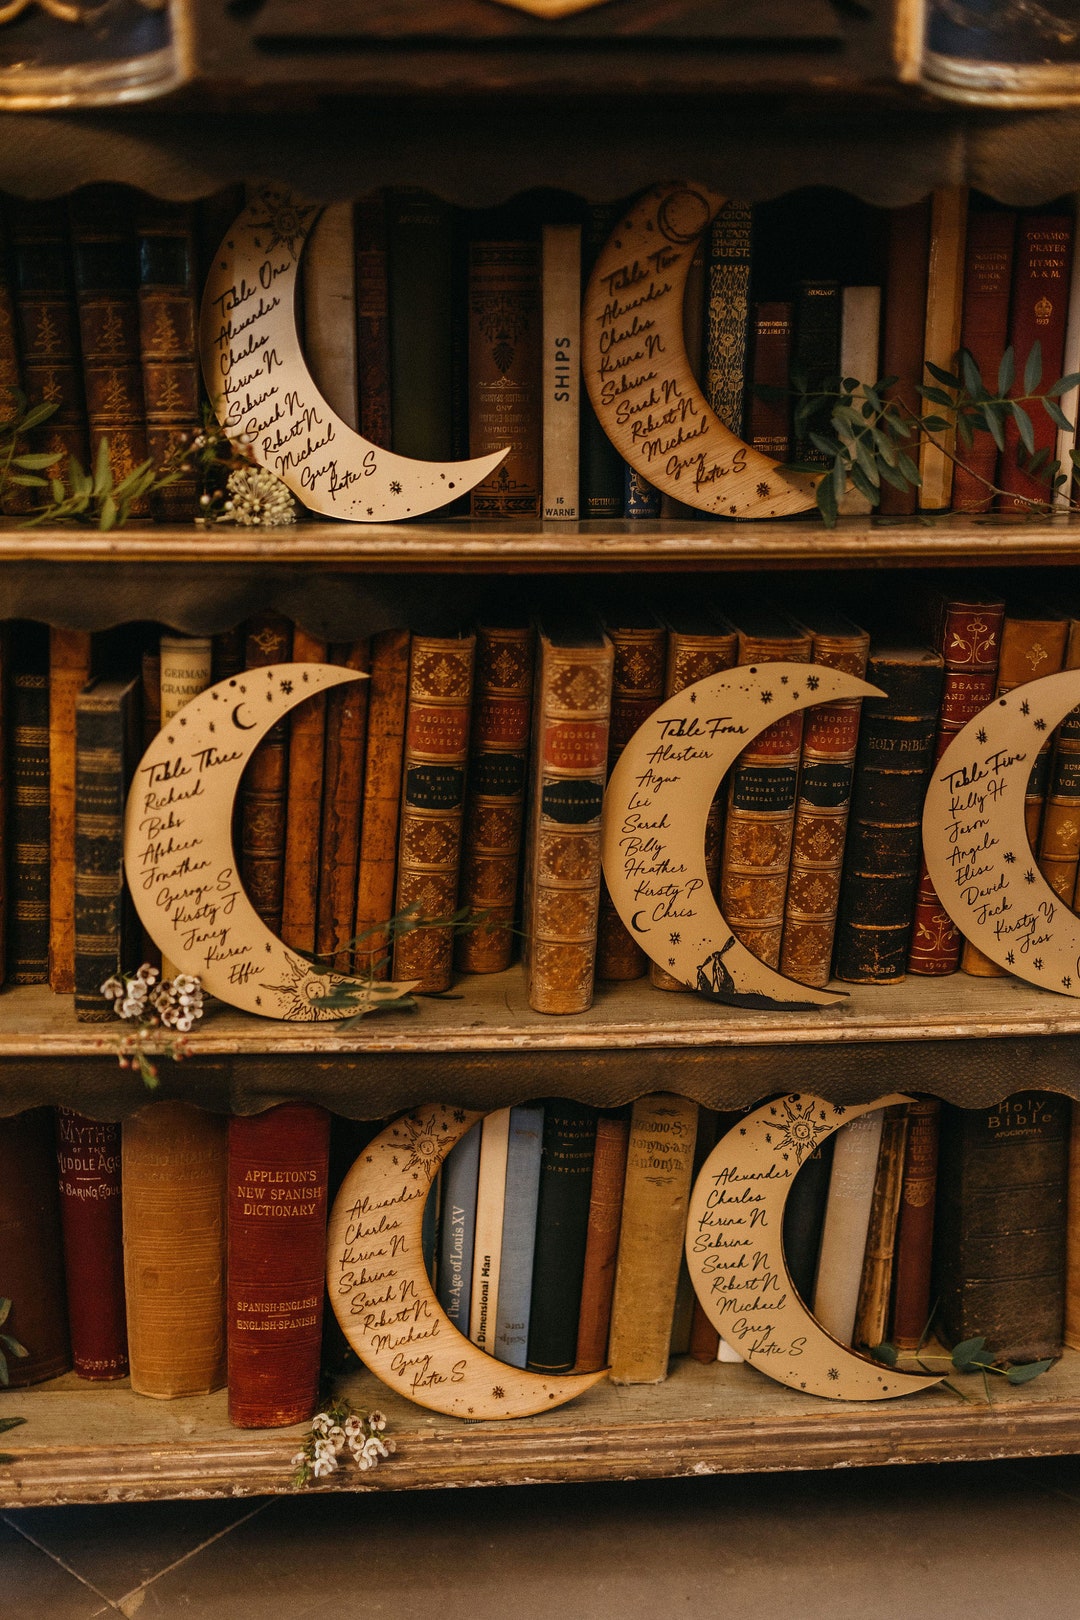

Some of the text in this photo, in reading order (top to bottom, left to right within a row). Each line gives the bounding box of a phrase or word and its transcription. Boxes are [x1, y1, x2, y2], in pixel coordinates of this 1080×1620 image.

[1026, 232, 1069, 240] COMMON
[1028, 244, 1066, 253] PRAYER
[601, 246, 682, 297] Table Two
[1029, 259, 1064, 268] HYMNS
[212, 261, 291, 318] Table One
[597, 282, 672, 328] Alexander
[214, 297, 280, 348] Alexander
[599, 319, 655, 354] Charles
[220, 336, 269, 376] Charles
[597, 334, 665, 382] Kerina N
[221, 349, 283, 402] Kerina N
[554, 337, 571, 402] SHIPS
[601, 370, 657, 406] Sabrina
[227, 387, 279, 427] Sabrina
[616, 379, 682, 425] Sarah N
[245, 391, 305, 444] Sarah N
[631, 397, 698, 442] Robert N
[261, 407, 322, 460] Robert N
[642, 416, 709, 462] Michael
[275, 423, 336, 476] Michael
[300, 459, 337, 490] Greg
[328, 451, 377, 501] Katie S
[665, 453, 707, 480] Greg
[693, 449, 748, 492] Katie S
[545, 507, 576, 517] WARNE
[944, 693, 991, 701] AND MAN
[951, 682, 986, 690] BEAST
[420, 715, 459, 724] GEORGE
[657, 719, 706, 739] Table
[705, 717, 749, 739] Four
[816, 715, 853, 724] GEORGE
[556, 730, 597, 739] GEORGE
[868, 738, 898, 750] HOLY
[141, 746, 244, 788] Table Three
[646, 744, 713, 765] Alastair
[940, 748, 1028, 795] Table Five
[144, 780, 205, 814] Richard
[627, 792, 652, 811] Lei
[948, 778, 1008, 820] Kelly H
[621, 814, 671, 833] Sarah
[944, 817, 990, 844] Jason
[137, 837, 203, 865] Afsheen
[619, 837, 667, 860] Billy
[945, 837, 1000, 868] Angela
[140, 859, 212, 890] Jonathan
[216, 868, 234, 892] S
[624, 857, 688, 880] Heather
[954, 865, 995, 886] Elise
[634, 878, 704, 904] Kirsty P
[960, 879, 1010, 907] David
[172, 892, 241, 931] Kirsty J
[651, 902, 697, 922] Chris
[973, 900, 1013, 926] Jack
[181, 926, 231, 951] Janey
[993, 913, 1040, 942] Kirsty
[204, 943, 254, 969] Kieran
[1016, 932, 1055, 955] Jess
[227, 961, 265, 985] Effie
[998, 1098, 1047, 1114] Holy
[59, 1120, 117, 1143] MYTHS
[987, 1110, 1053, 1129] Bible
[57, 1152, 96, 1174] MIDDLE
[244, 1170, 318, 1182] APPLETON'S
[712, 1163, 792, 1186] Alexander
[66, 1184, 98, 1201] BARING
[237, 1186, 322, 1200] NEW SPANISH
[346, 1186, 424, 1221] Alexander
[706, 1190, 765, 1209] Charles
[243, 1203, 316, 1217] DICTIONARY
[698, 1208, 768, 1231] Kerina N
[345, 1215, 402, 1247] Charles
[693, 1233, 753, 1252] Sabrina
[339, 1234, 409, 1271] Kerina N
[447, 1205, 465, 1318] The Age of Louis XV
[701, 1251, 771, 1274] Sarah N
[338, 1268, 397, 1295] Sabrina
[710, 1272, 780, 1295] Robert N
[237, 1298, 318, 1312] SPANISH-ENGLISH
[350, 1279, 419, 1315] Sarah N
[477, 1255, 491, 1343] Dimensional Man
[716, 1294, 786, 1315] Michael
[237, 1315, 317, 1331] ENGLISH-SPANISH
[362, 1299, 432, 1337] Robert N
[731, 1318, 776, 1340] Greg
[371, 1320, 441, 1354] Michael
[748, 1337, 807, 1360] Katie S
[390, 1352, 433, 1376] Greg
[410, 1360, 468, 1395] Katie S
